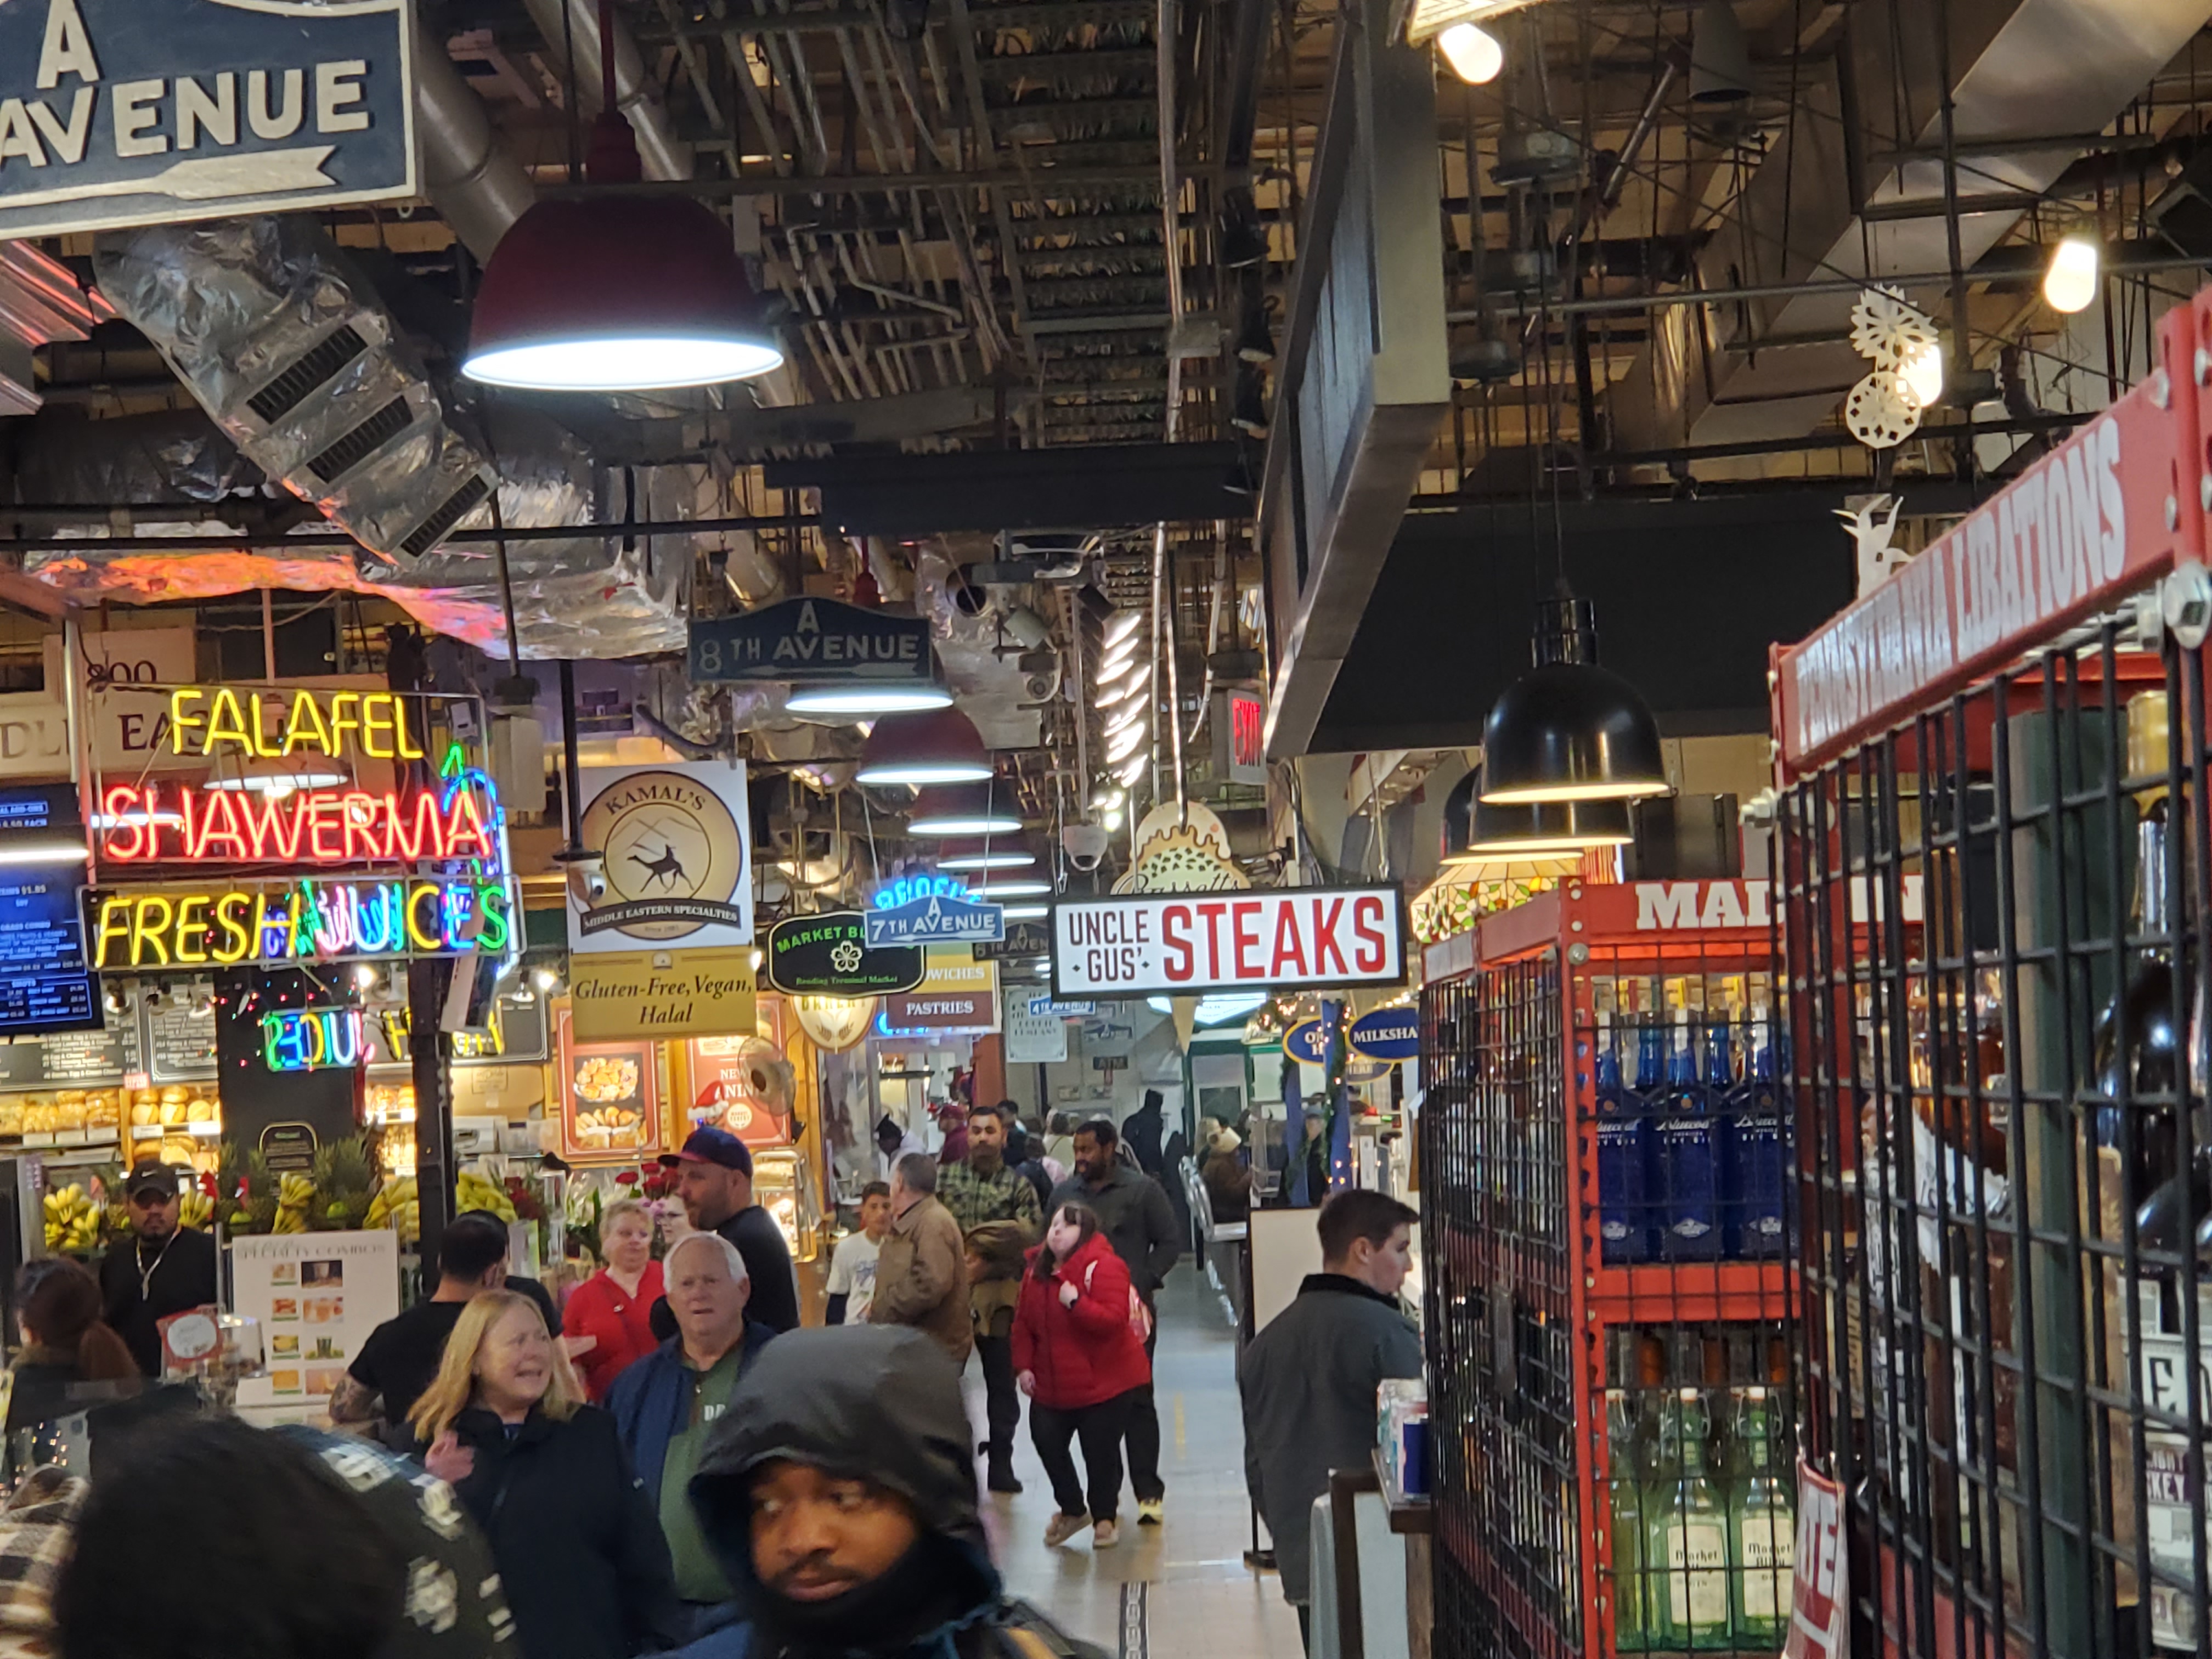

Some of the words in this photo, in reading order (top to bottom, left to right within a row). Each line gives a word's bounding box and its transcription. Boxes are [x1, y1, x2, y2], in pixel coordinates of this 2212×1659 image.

[0, 60, 369, 167] AVENUE
[1952, 417, 2126, 663] LIBATIONS
[772, 634, 919, 659] AVENUE
[172, 689, 424, 758] FALAFEL
[1232, 698, 1261, 767] EXIT
[605, 785, 706, 816] KAMAL'S
[105, 786, 493, 860] SHAWERMA
[95, 891, 300, 968] FRESH
[314, 882, 509, 952] JUICES
[584, 911, 624, 929] MIDDLE
[626, 905, 673, 918] EASTERN
[674, 905, 737, 922] SPECIALTIES
[913, 913, 996, 933] AVENUE
[1069, 909, 1149, 946] UNCLE
[776, 926, 843, 953] MARKET
[1008, 938, 1048, 951] AVEN
[1087, 946, 1142, 983] GUS'
[1161, 896, 1386, 982] STEAKS
[575, 977, 691, 1000] Gluten-Free,
[695, 974, 752, 1000] Vegan,
[926, 967, 985, 981] WICHES
[639, 1002, 693, 1025] Halal
[906, 1000, 974, 1015] PASTRIES
[1353, 1026, 1418, 1043] MILKSHA
